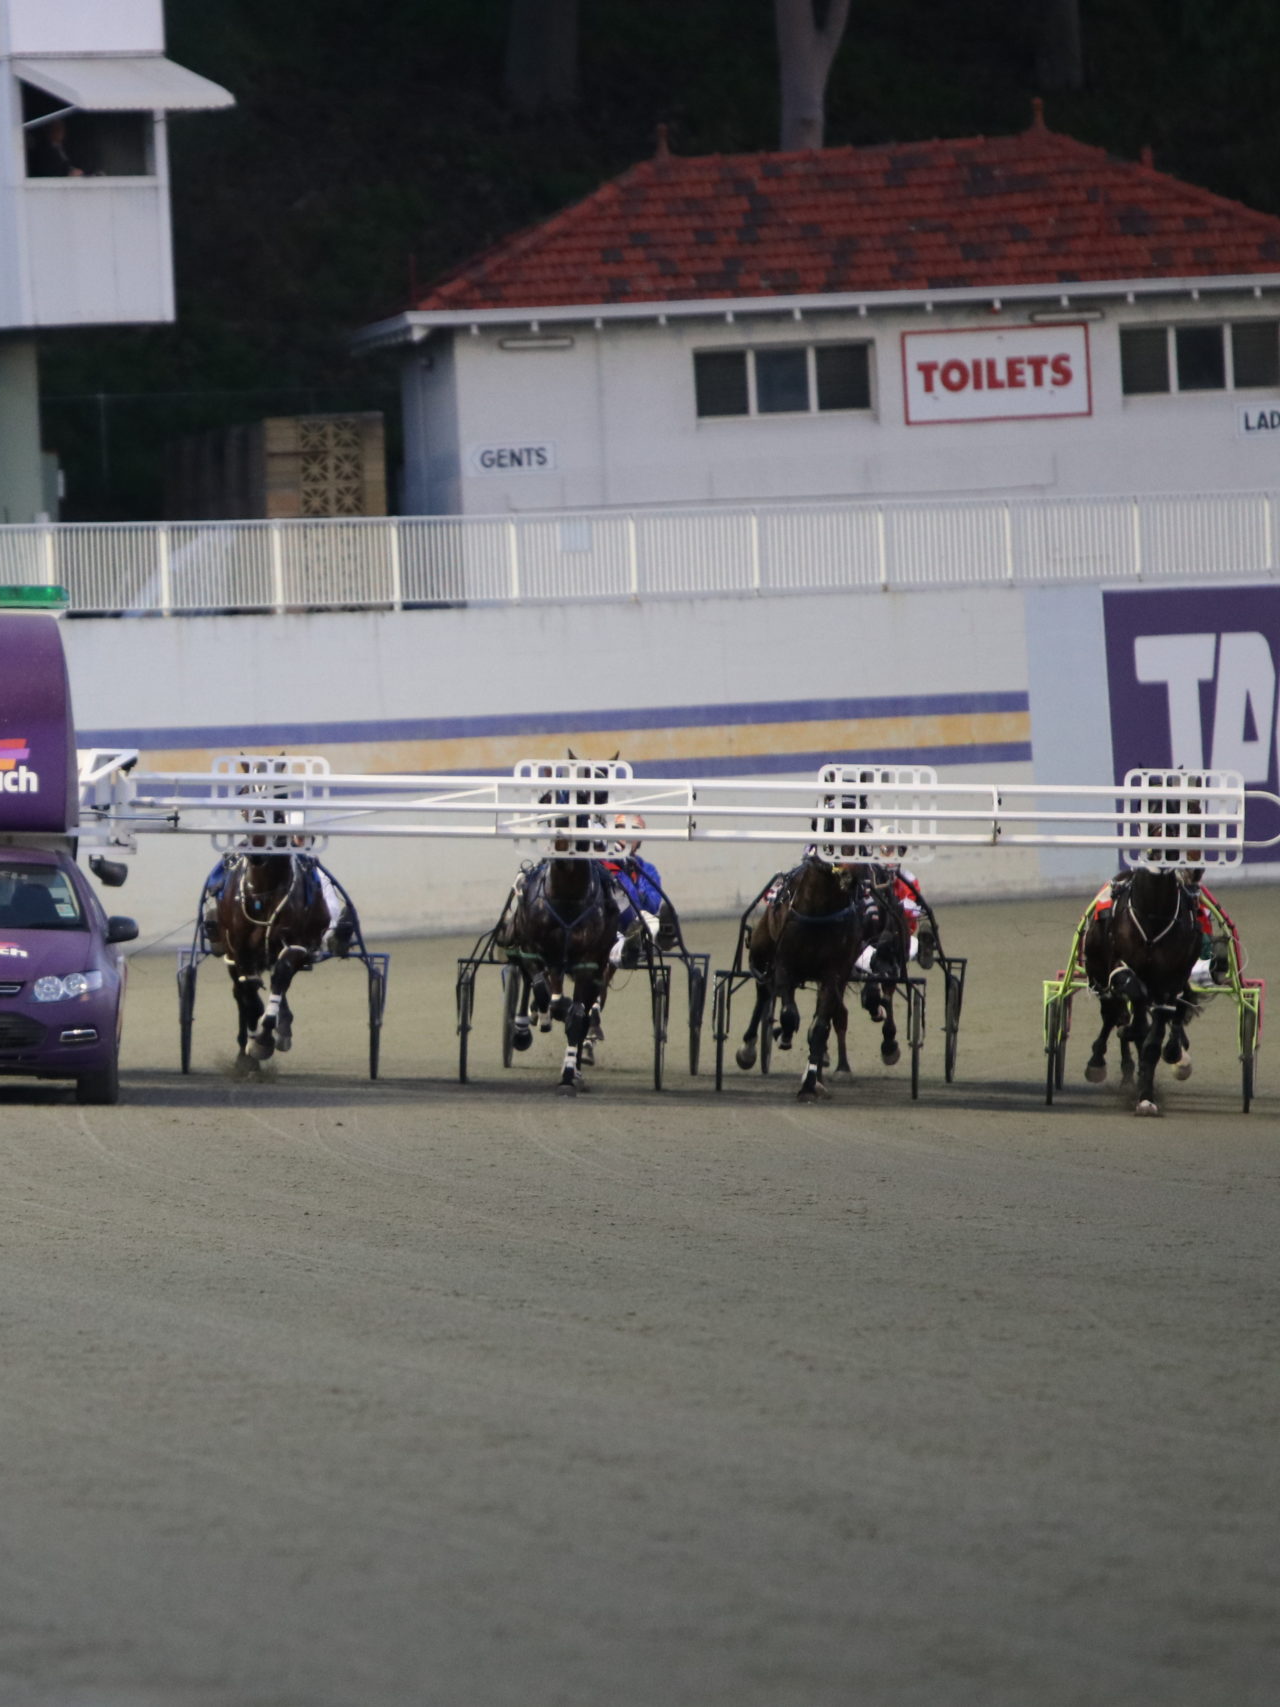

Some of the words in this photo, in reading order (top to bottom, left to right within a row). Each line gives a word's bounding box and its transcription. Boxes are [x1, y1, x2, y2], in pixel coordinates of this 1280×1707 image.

[917, 353, 1073, 392] TOILETS
[1244, 410, 1280, 430] LAD
[480, 446, 547, 468] GENTS
[1134, 631, 1280, 813] TA
